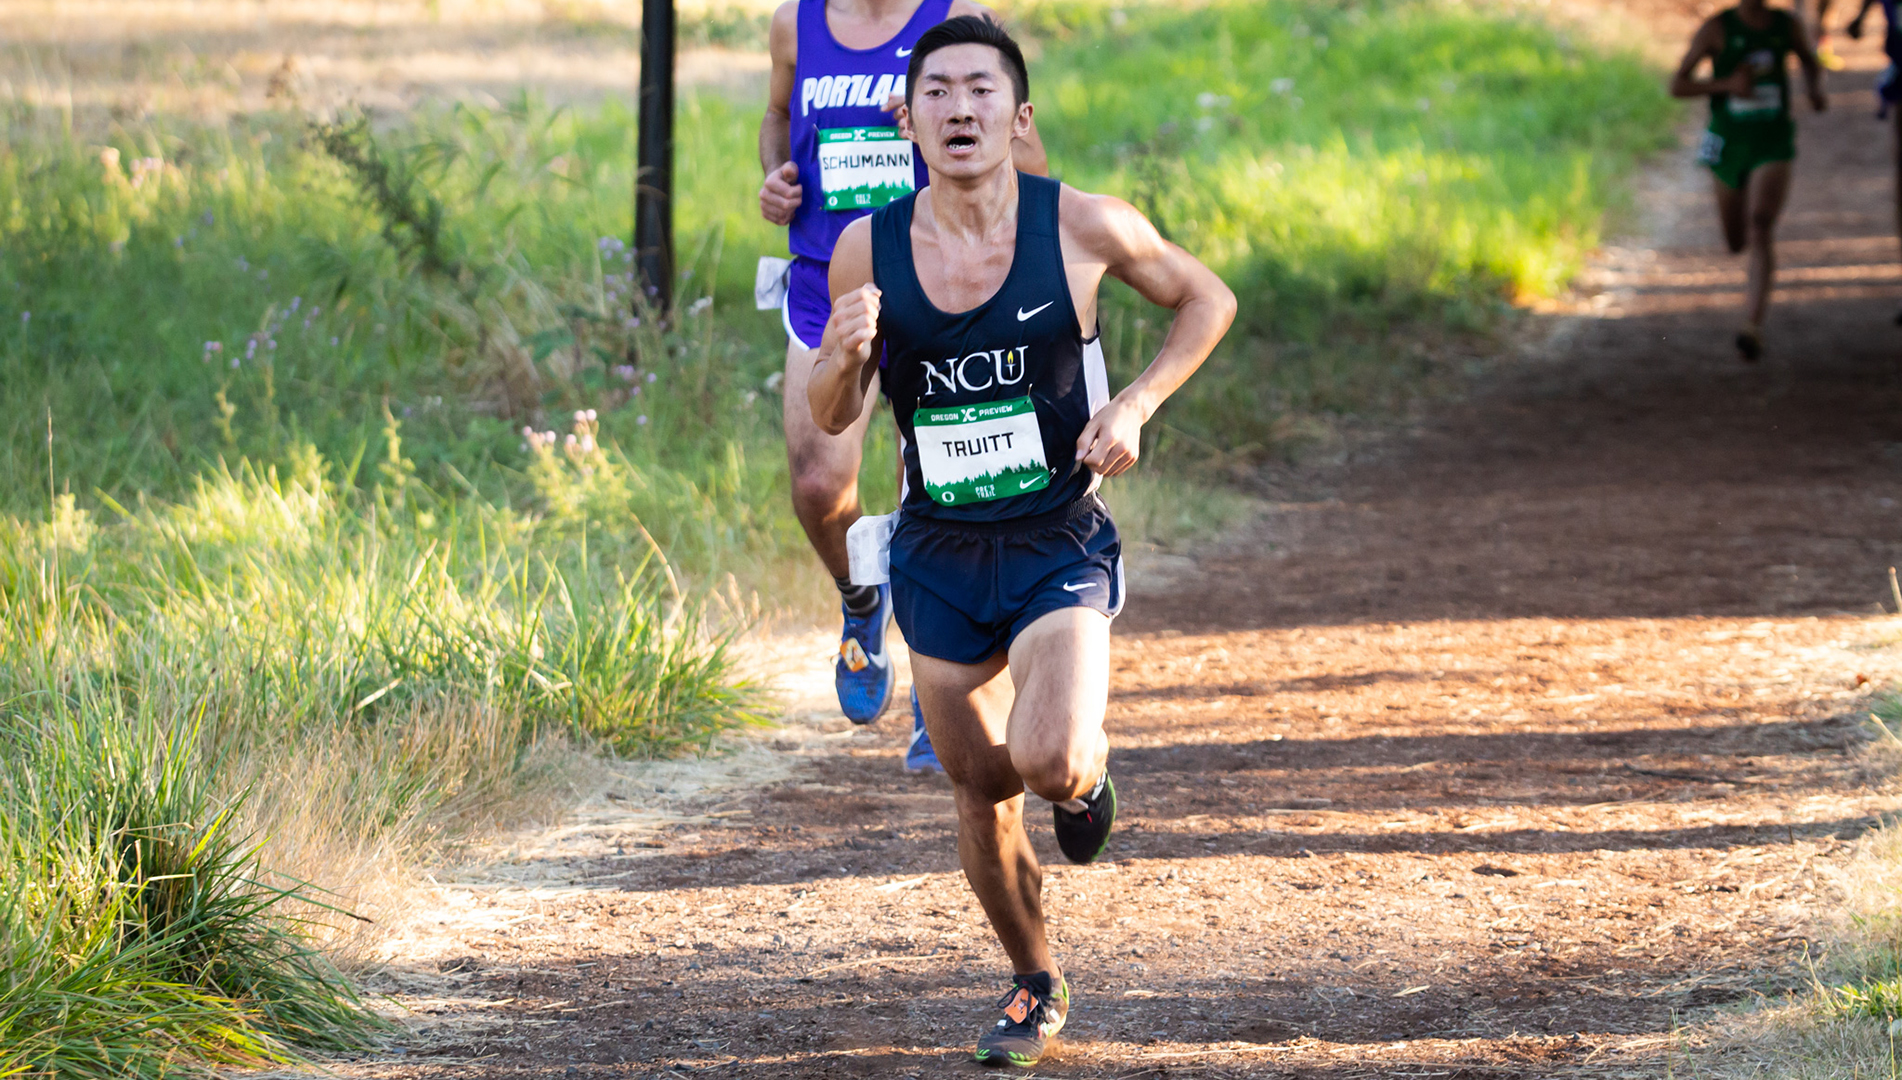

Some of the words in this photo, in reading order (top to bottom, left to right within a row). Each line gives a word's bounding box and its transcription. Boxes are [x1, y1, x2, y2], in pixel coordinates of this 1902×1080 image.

[822, 153, 910, 170] SCHUMANN
[920, 345, 1029, 396] NCU
[930, 413, 959, 422] OREGON
[978, 405, 1013, 417] PREVIEW
[942, 432, 1014, 458] TRUITT
